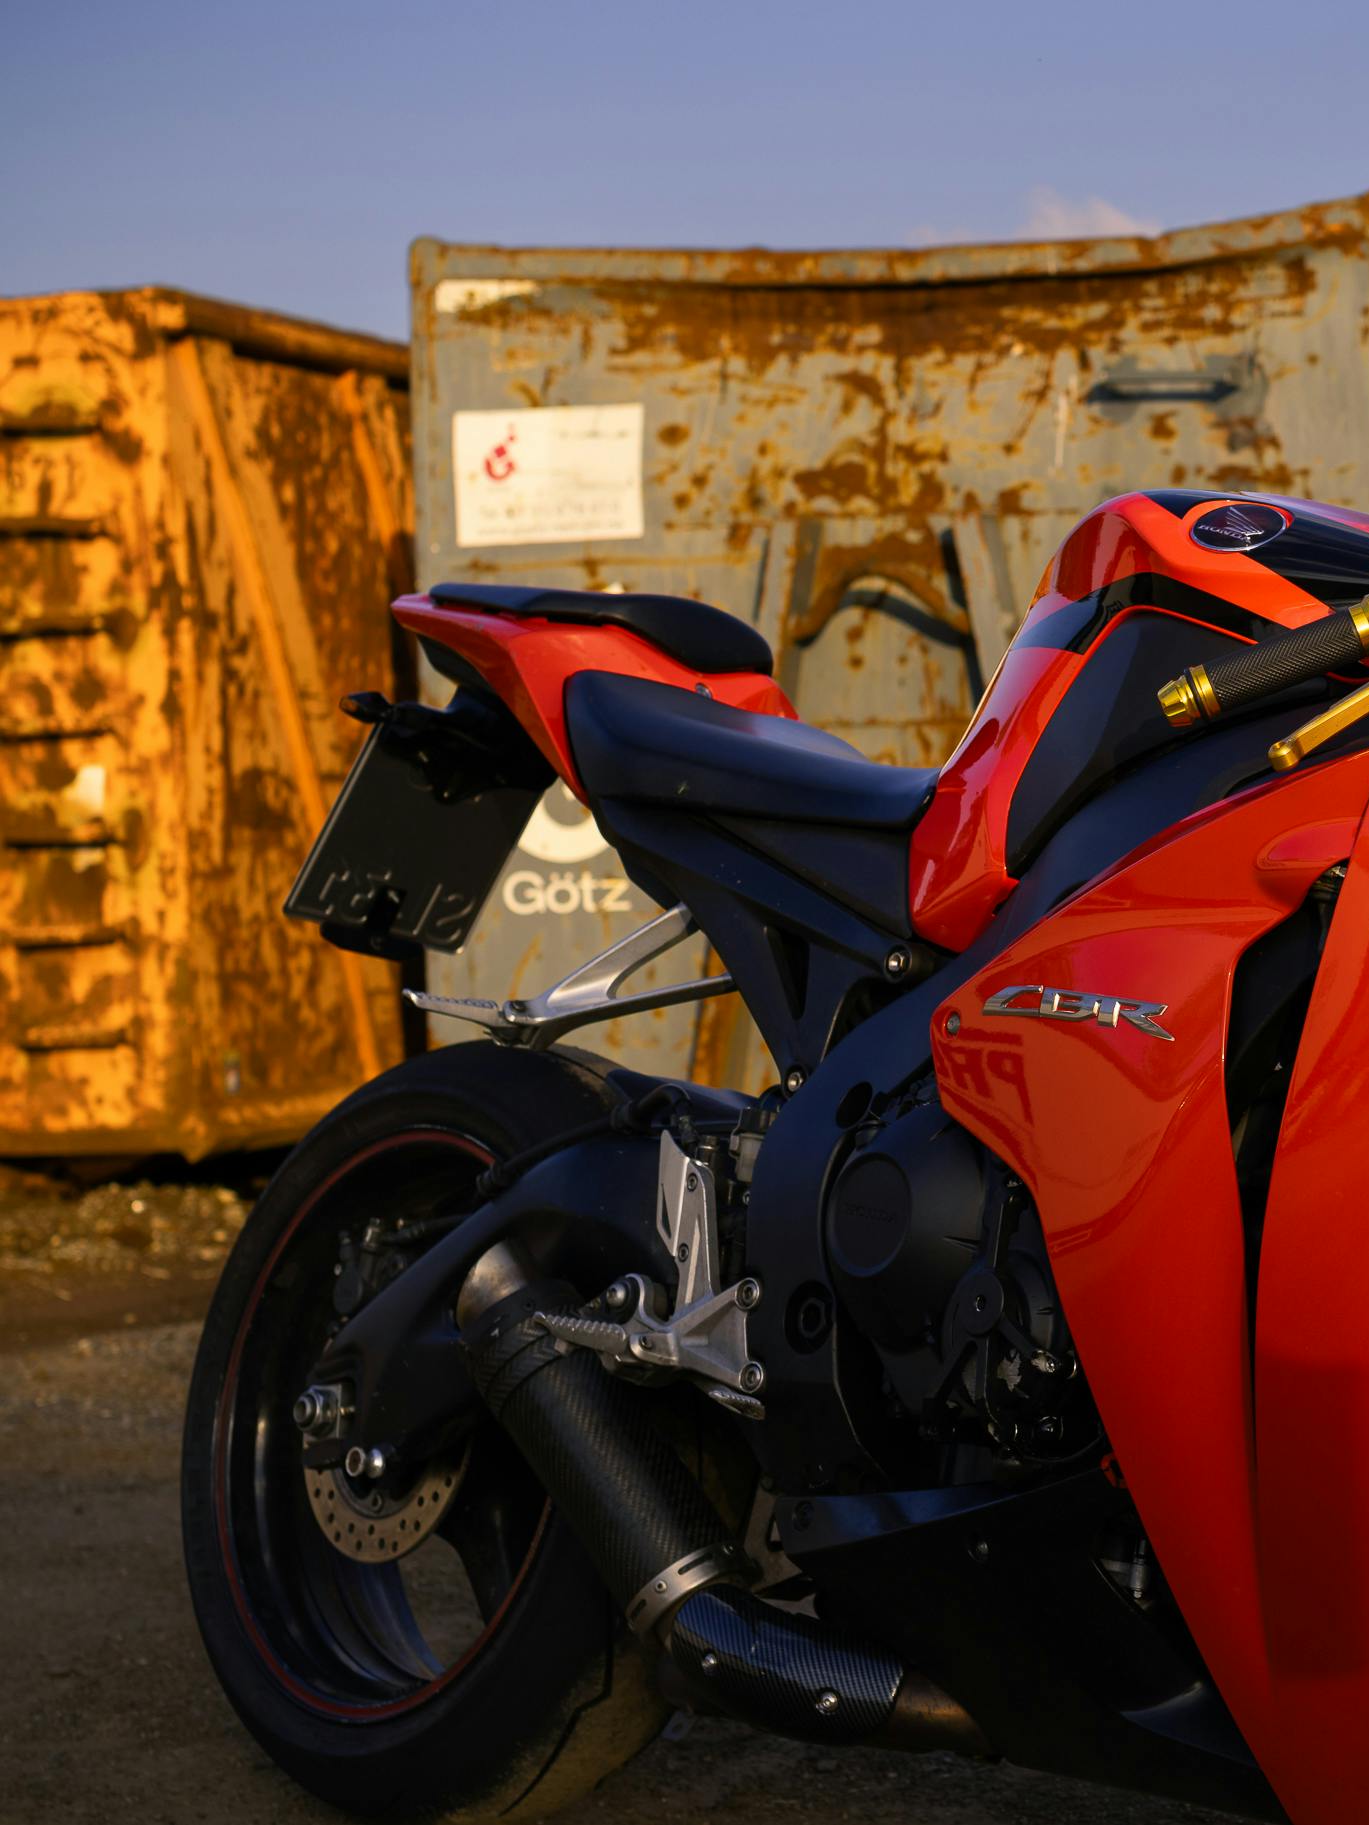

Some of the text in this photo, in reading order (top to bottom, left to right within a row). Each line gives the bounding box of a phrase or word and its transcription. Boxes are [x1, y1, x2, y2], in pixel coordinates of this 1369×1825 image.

[1198, 525, 1252, 544] HONDA
[503, 870, 632, 915] Götz
[982, 985, 1175, 1041] CBR
